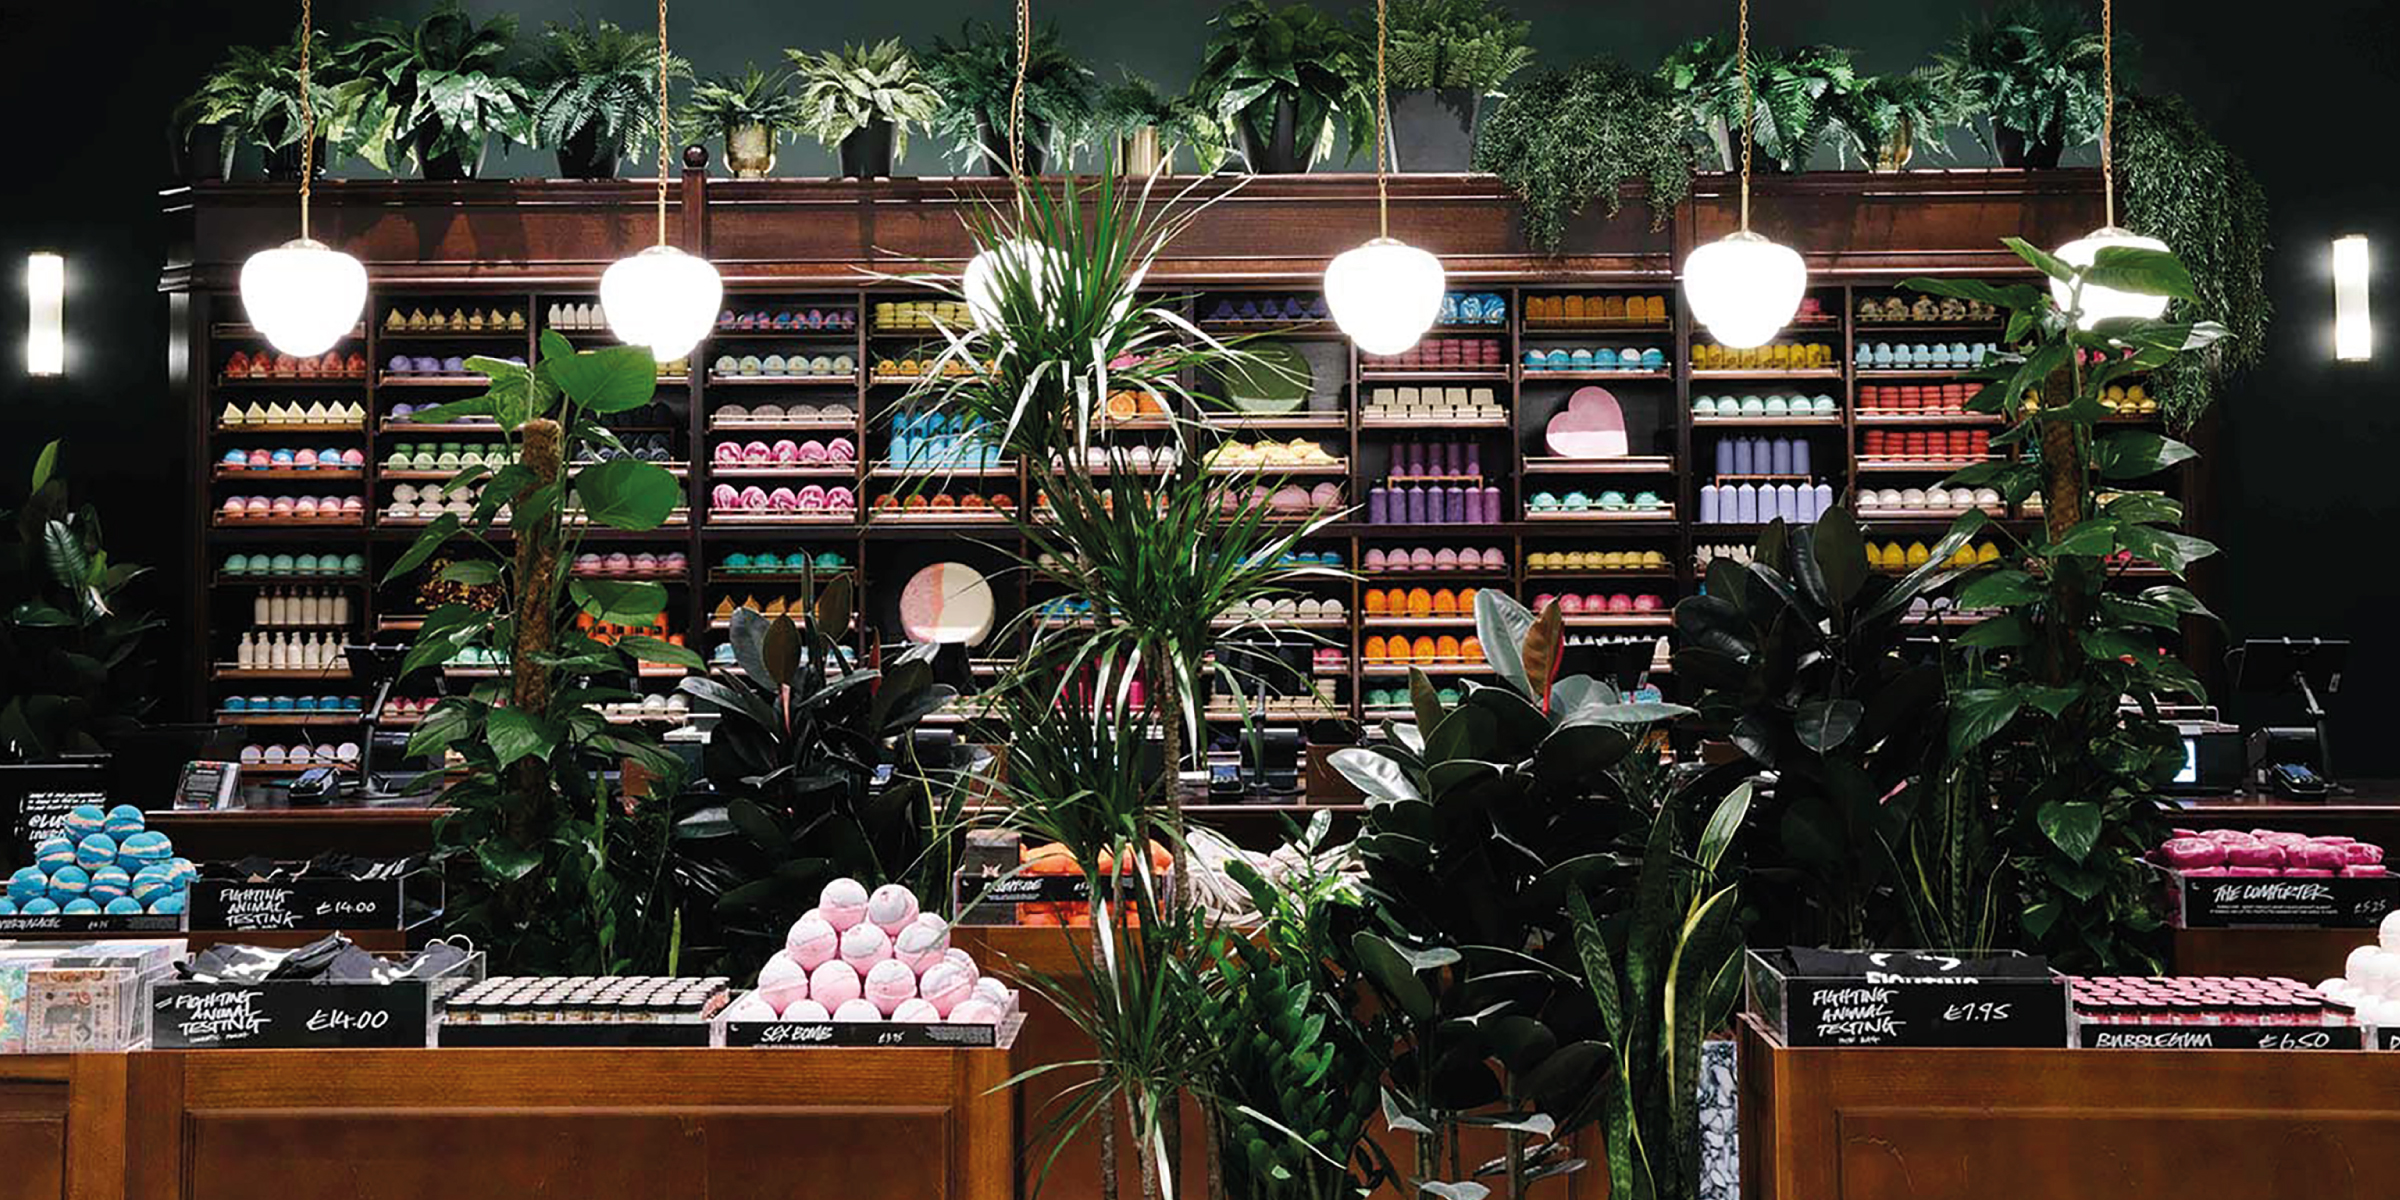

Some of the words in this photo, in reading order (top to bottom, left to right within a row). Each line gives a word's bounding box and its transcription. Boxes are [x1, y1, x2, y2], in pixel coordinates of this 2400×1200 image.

[219, 888, 295, 903] FIGHTING
[2212, 885, 2241, 903] THE
[2243, 882, 2335, 901] COMFORTER
[227, 900, 286, 915] ANIMAL
[316, 901, 376, 915] £14.00
[224, 911, 304, 929] TESTING
[175, 990, 264, 1009] FIGHTING
[1812, 987, 1900, 1007] FIGHTING
[190, 1006, 263, 1021] ANIMAL
[305, 1009, 389, 1031] £14.00
[1821, 1004, 1895, 1023] ANIMAL
[1943, 1002, 2013, 1022] £7.95
[178, 1018, 272, 1037] TESTING
[760, 1025, 792, 1043] SEX
[1816, 1018, 1907, 1037] TESTING
[2096, 1031, 2214, 1049] BUBBLEGUM
